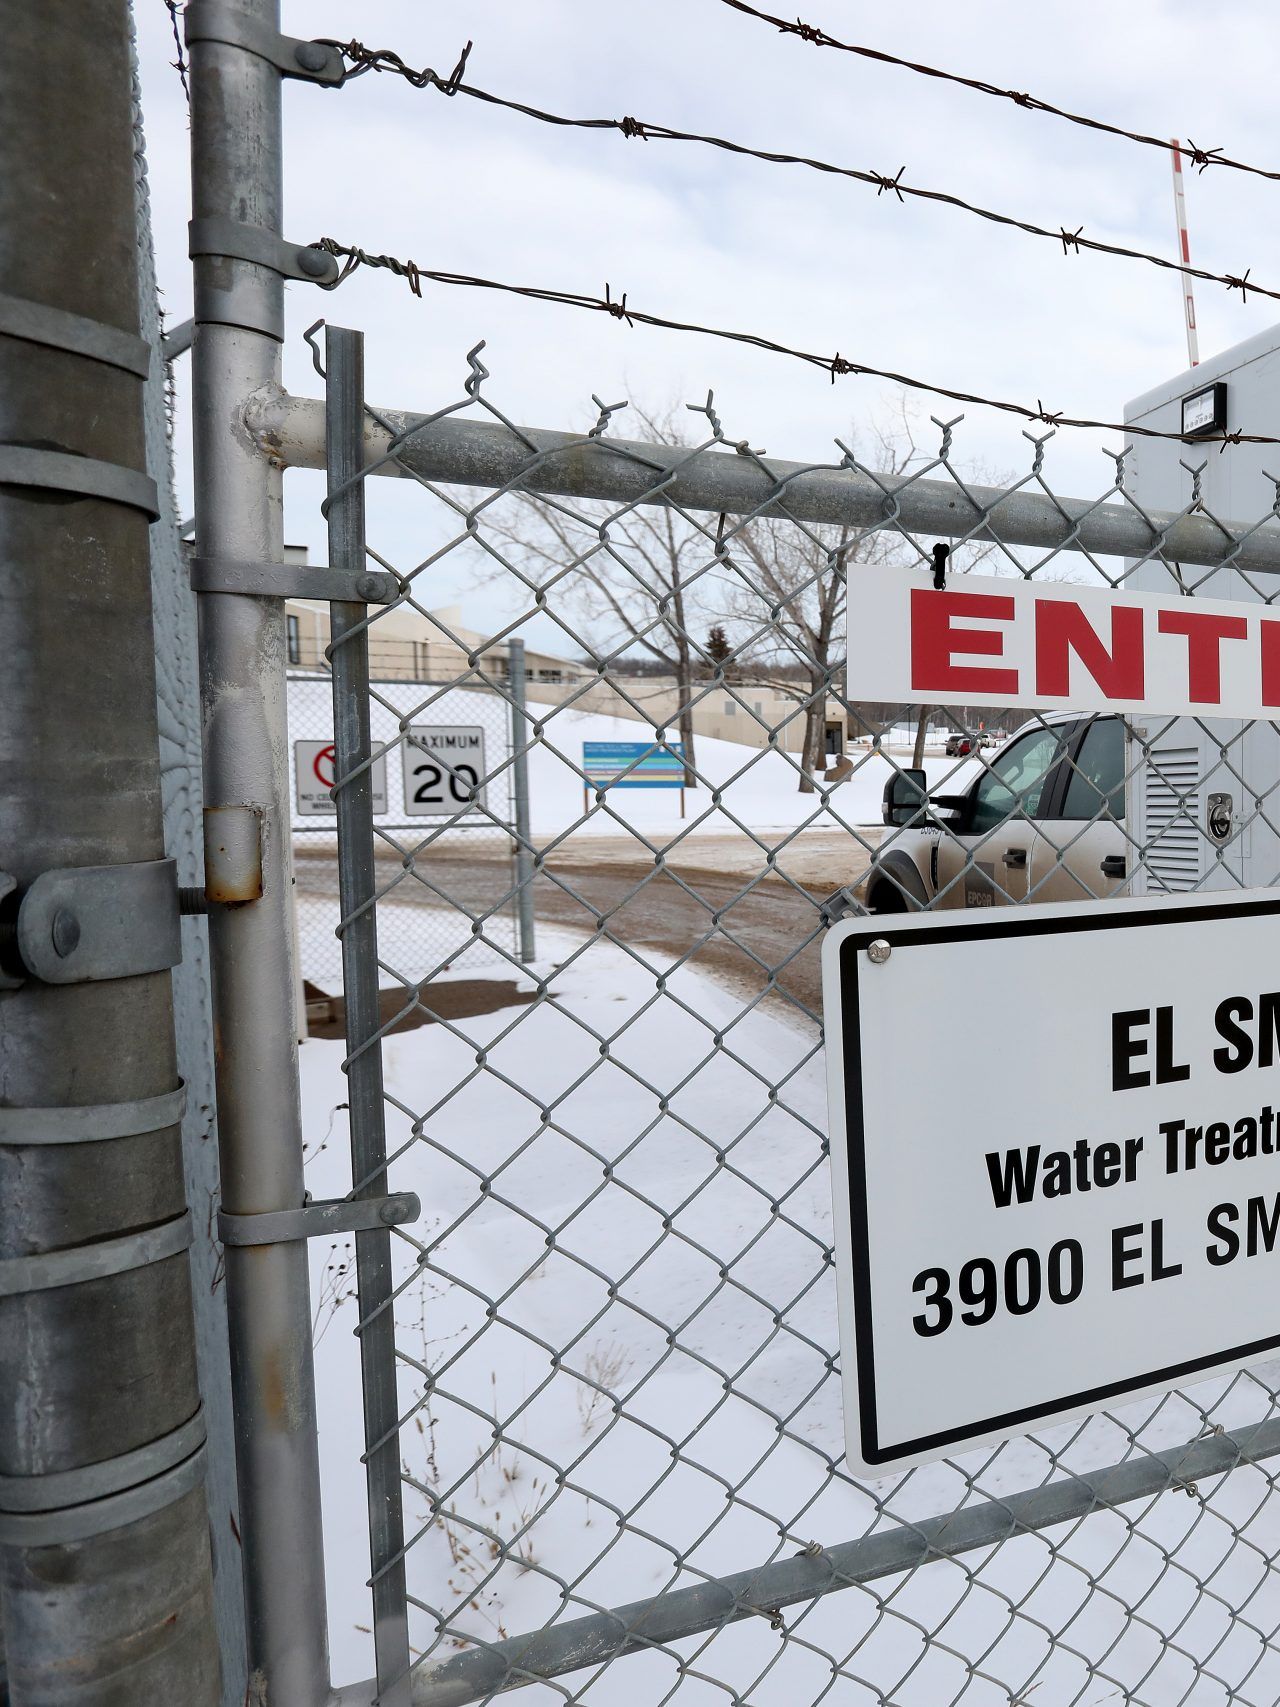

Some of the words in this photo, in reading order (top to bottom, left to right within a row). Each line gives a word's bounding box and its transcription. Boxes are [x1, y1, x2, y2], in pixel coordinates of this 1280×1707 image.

[413, 764, 478, 803] 20
[1112, 1005, 1190, 1092] EL
[985, 1136, 1143, 1209] Water
[911, 1238, 1084, 1337] 3900
[1111, 1218, 1183, 1292] EL
